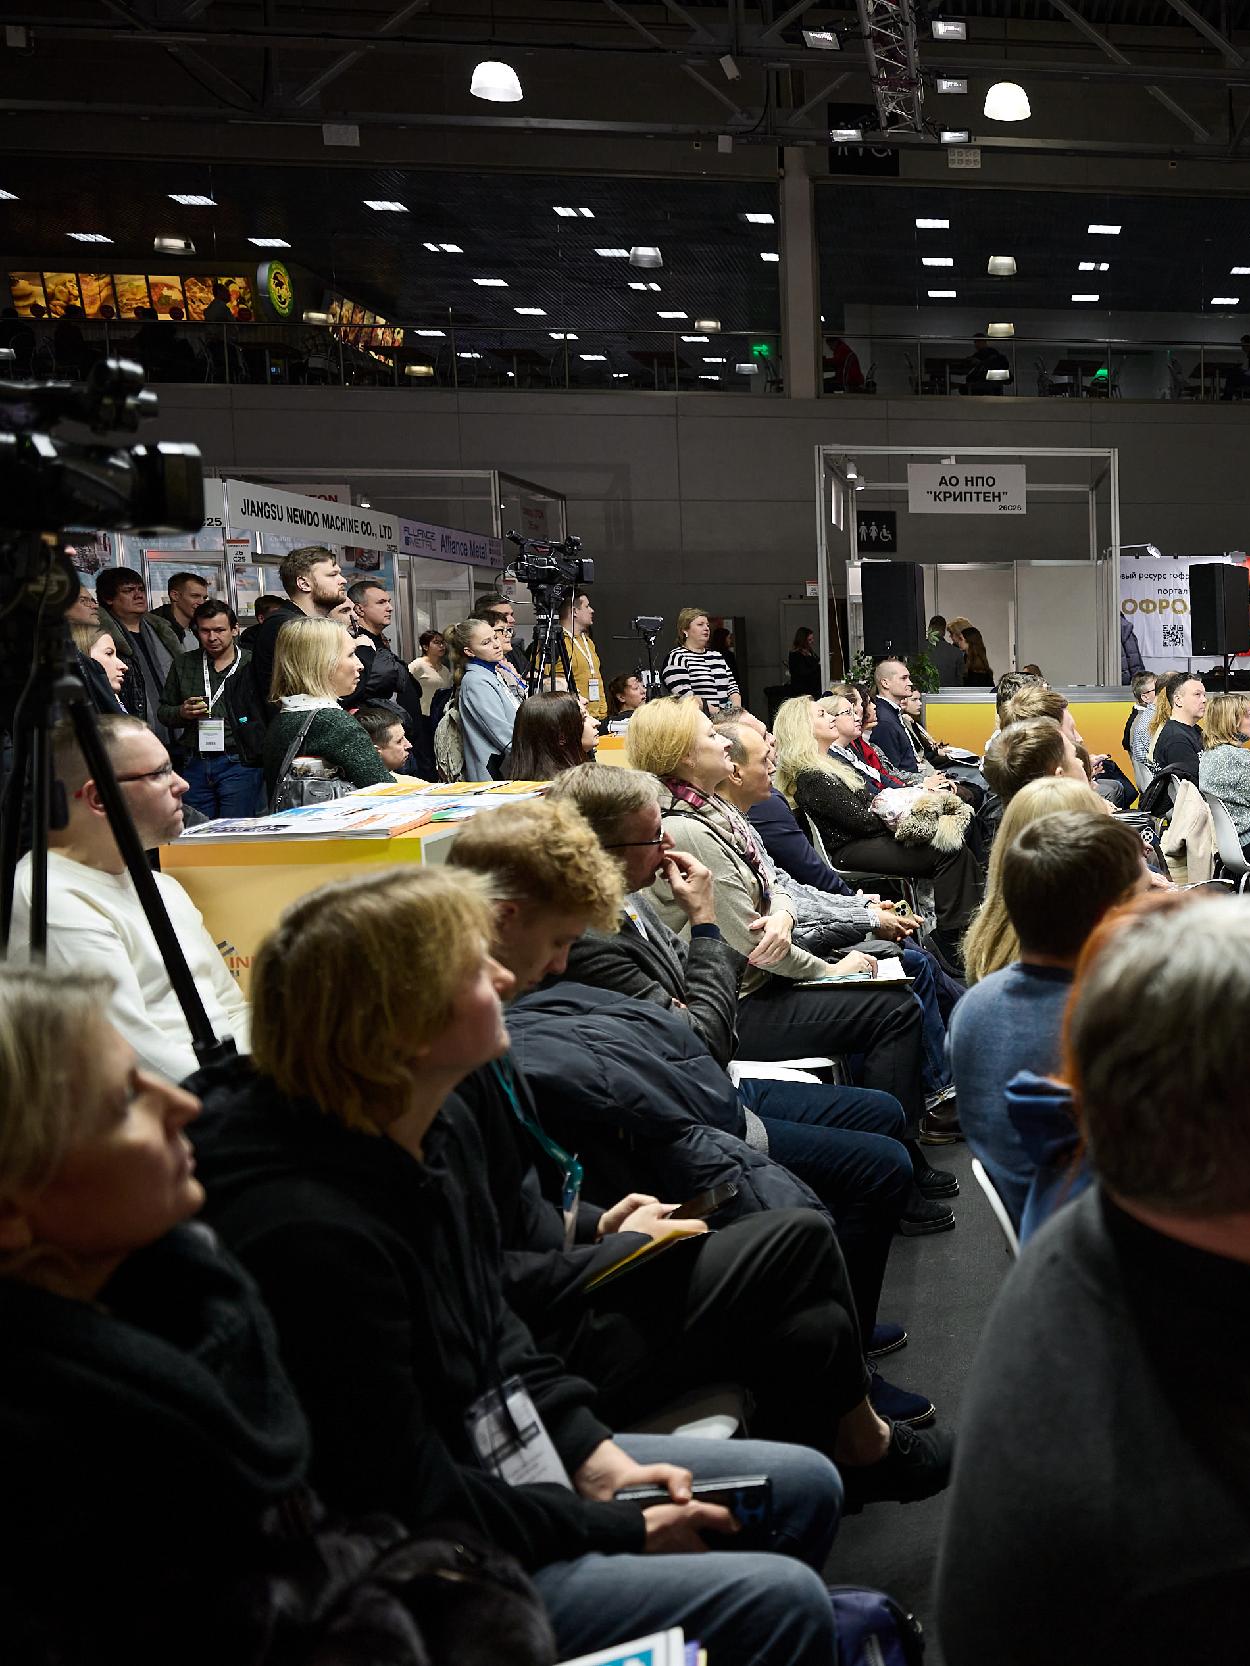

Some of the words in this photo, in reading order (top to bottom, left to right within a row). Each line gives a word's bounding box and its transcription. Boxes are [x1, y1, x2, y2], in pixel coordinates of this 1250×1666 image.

[938, 475, 960, 488] АО
[964, 475, 996, 488] НПО
[926, 491, 1008, 503] "КРИПТЕН"
[240, 499, 284, 522] JIANGSU
[286, 507, 320, 528] NEWDO
[321, 513, 360, 534] MACHINE
[360, 521, 378, 539] CO.,
[379, 524, 392, 540] LTD
[440, 534, 468, 557] Alliance
[469, 541, 488, 560] Metal
[1138, 573, 1167, 581] ресурс
[230, 955, 256, 968] IN
